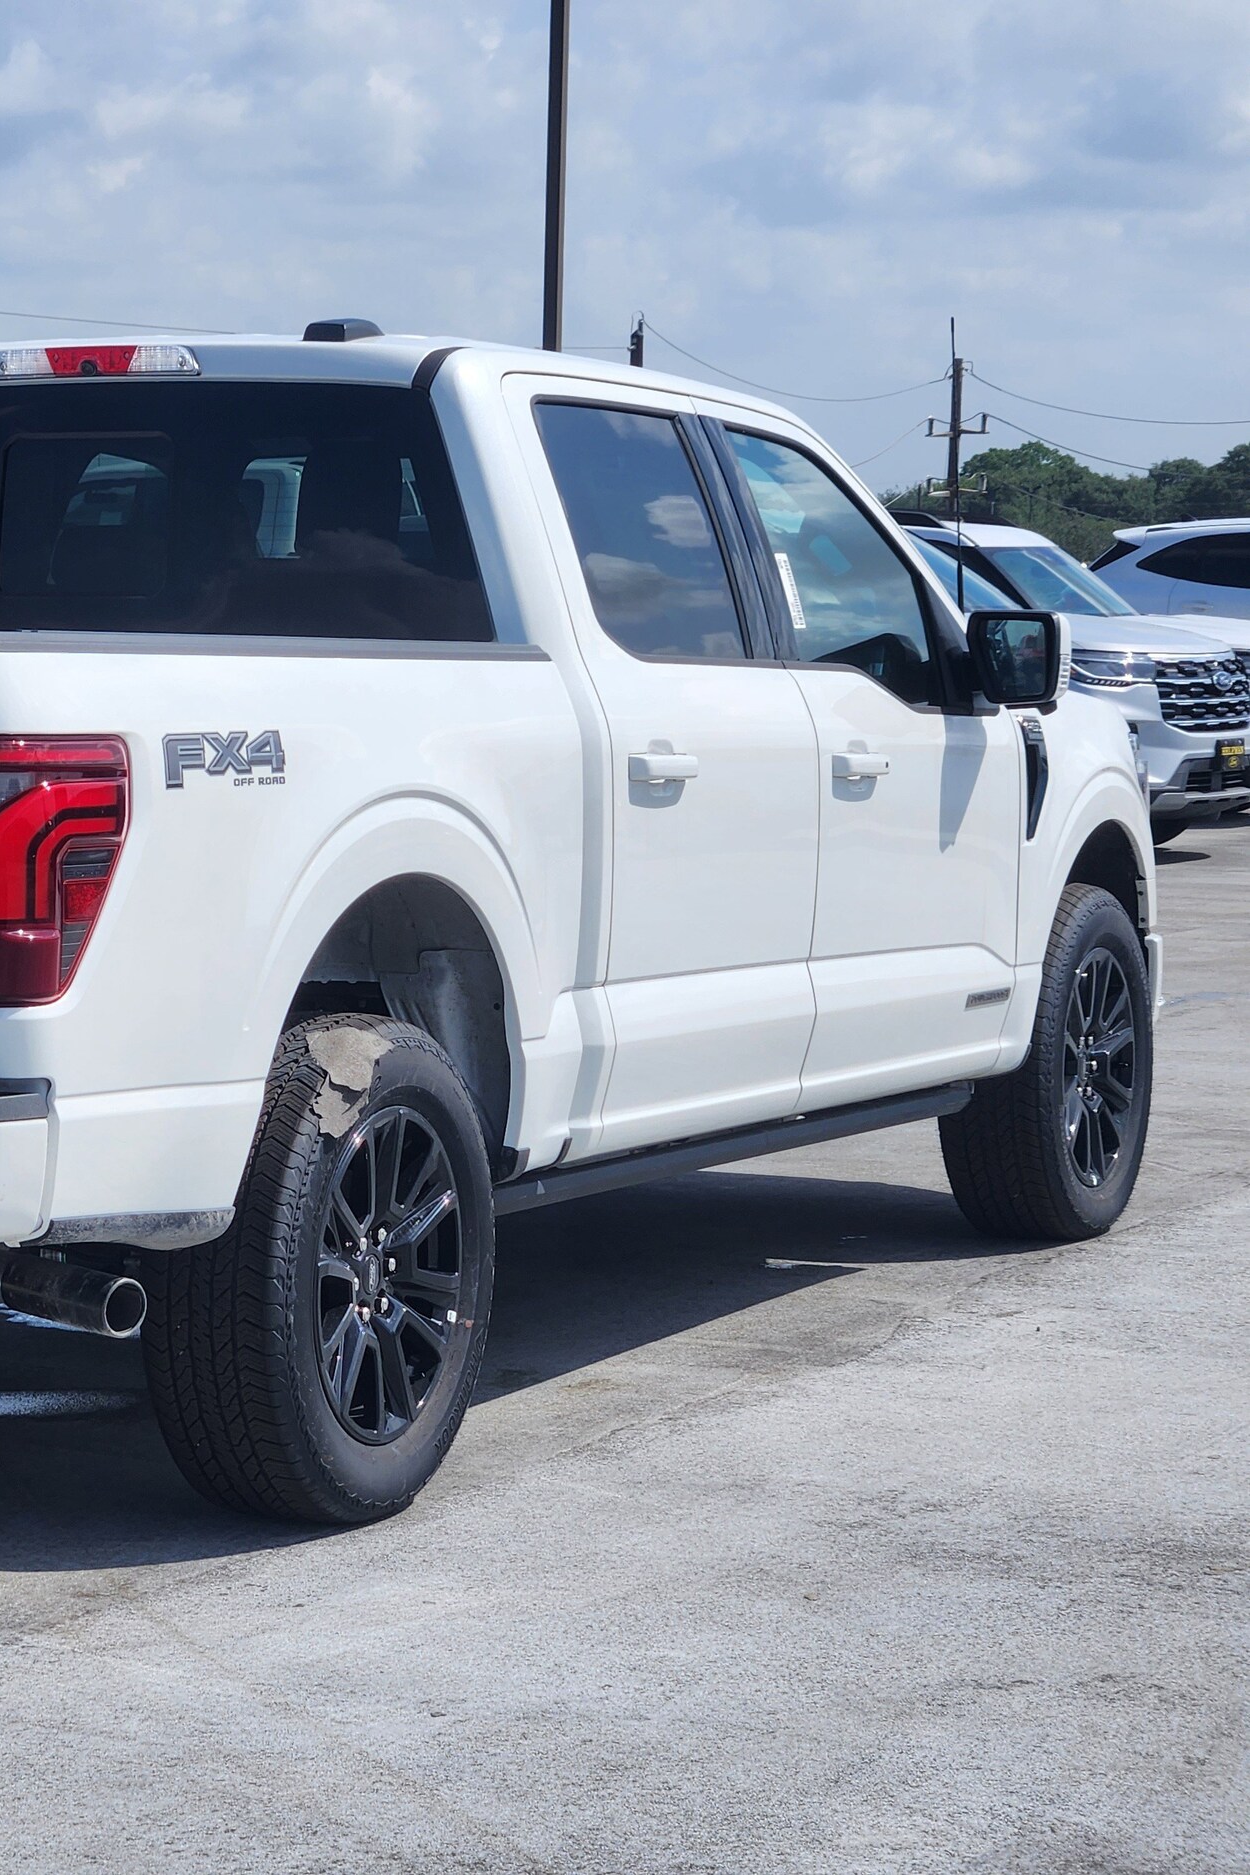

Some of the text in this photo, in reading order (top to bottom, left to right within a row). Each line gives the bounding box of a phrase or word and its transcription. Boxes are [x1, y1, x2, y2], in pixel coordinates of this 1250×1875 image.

[162, 729, 286, 790] FX4
[233, 776, 286, 787] OFF ROAD
